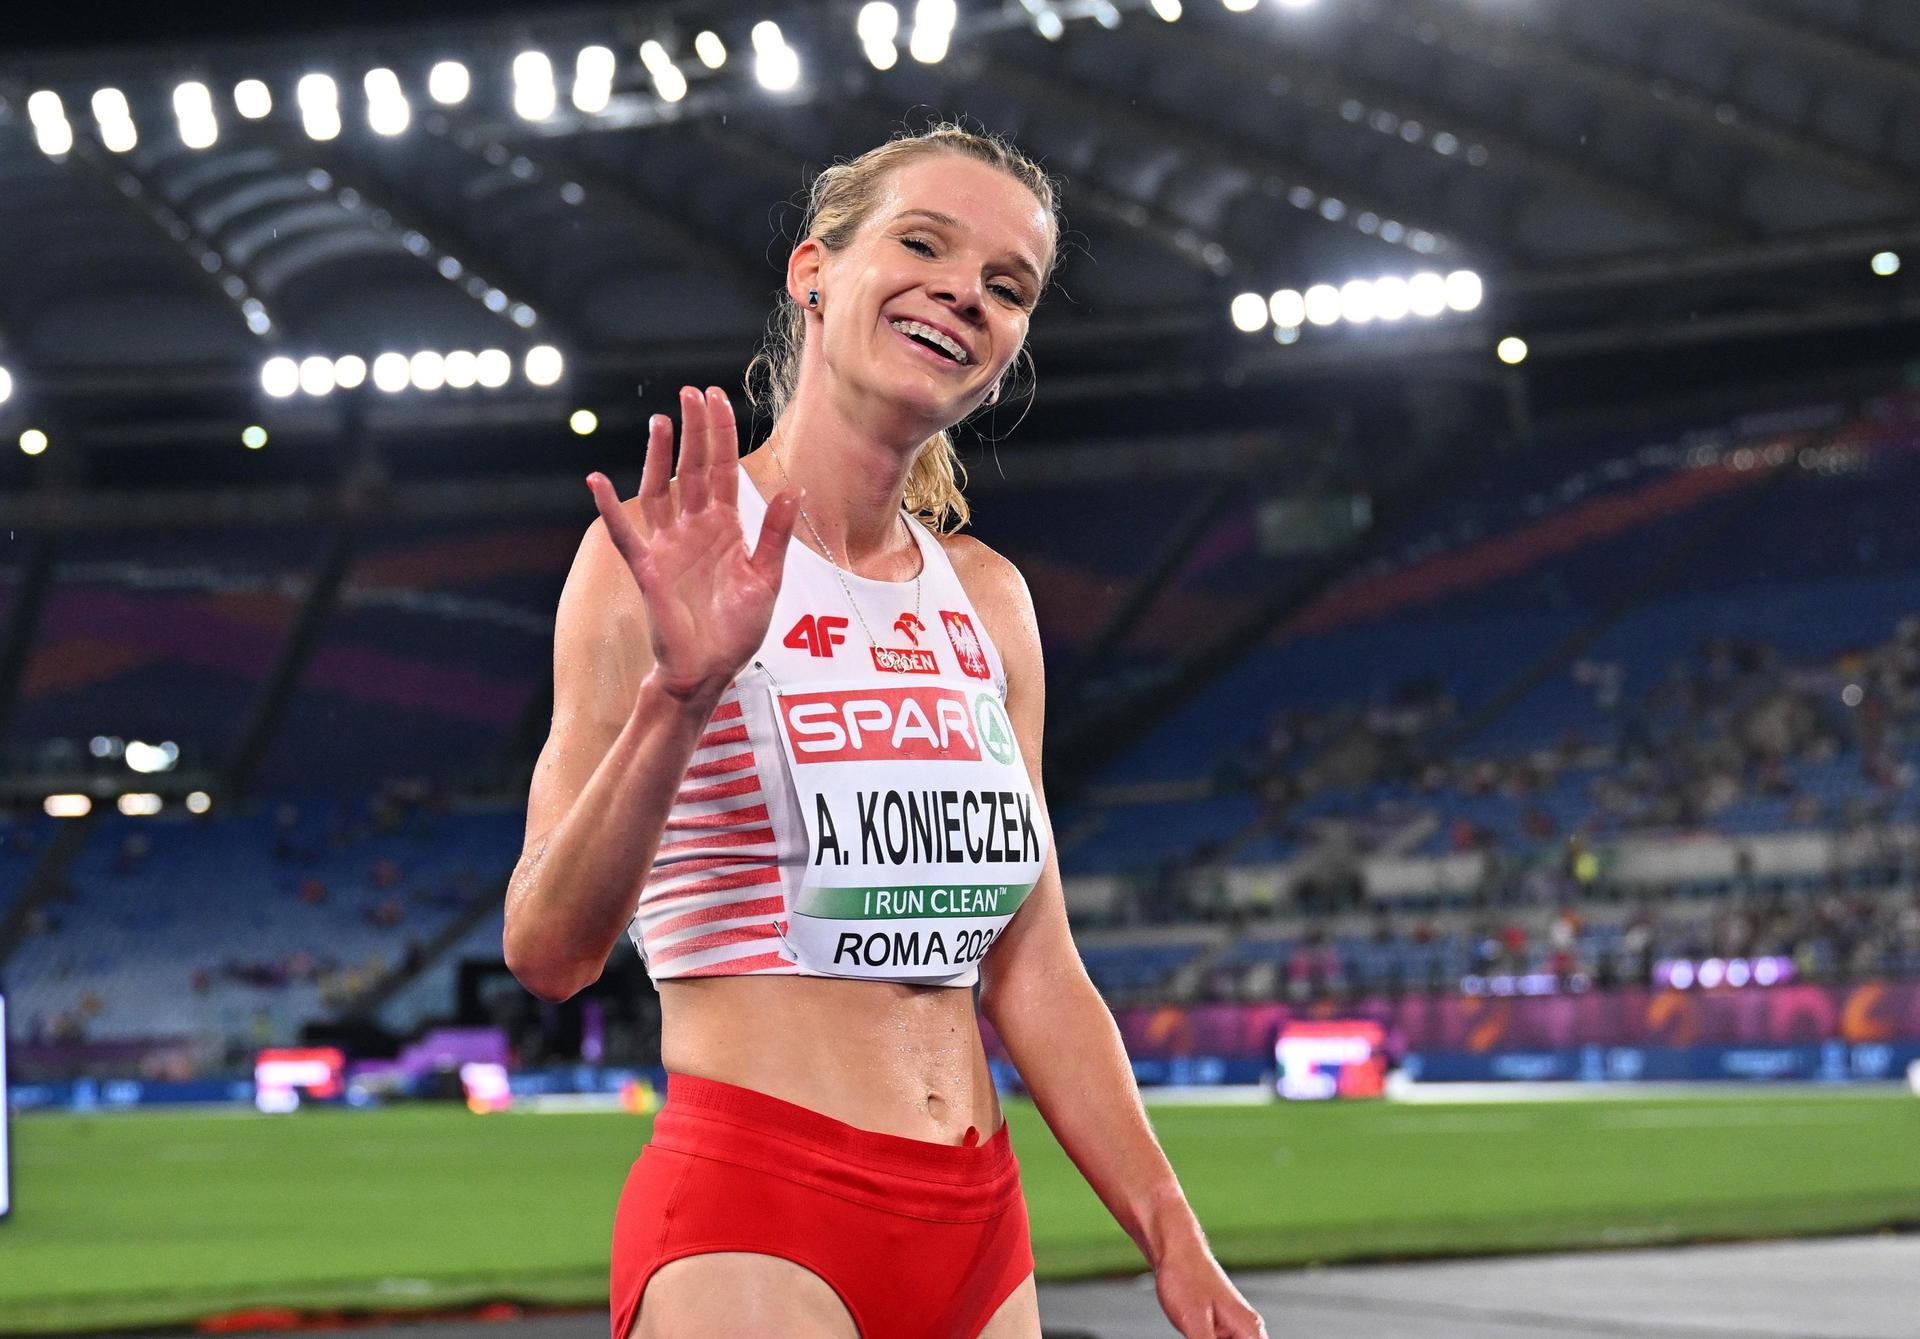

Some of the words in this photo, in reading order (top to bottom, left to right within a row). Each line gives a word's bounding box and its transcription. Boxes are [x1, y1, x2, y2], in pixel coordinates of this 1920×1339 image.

[783, 614, 849, 657] 4F
[789, 697, 975, 752] SPAR
[815, 793, 849, 865] A.
[857, 790, 1040, 865] KONIECZEK
[863, 890, 870, 915] I
[876, 890, 924, 914] RUN
[834, 931, 948, 966] ROMA
[954, 927, 1002, 964] 202
